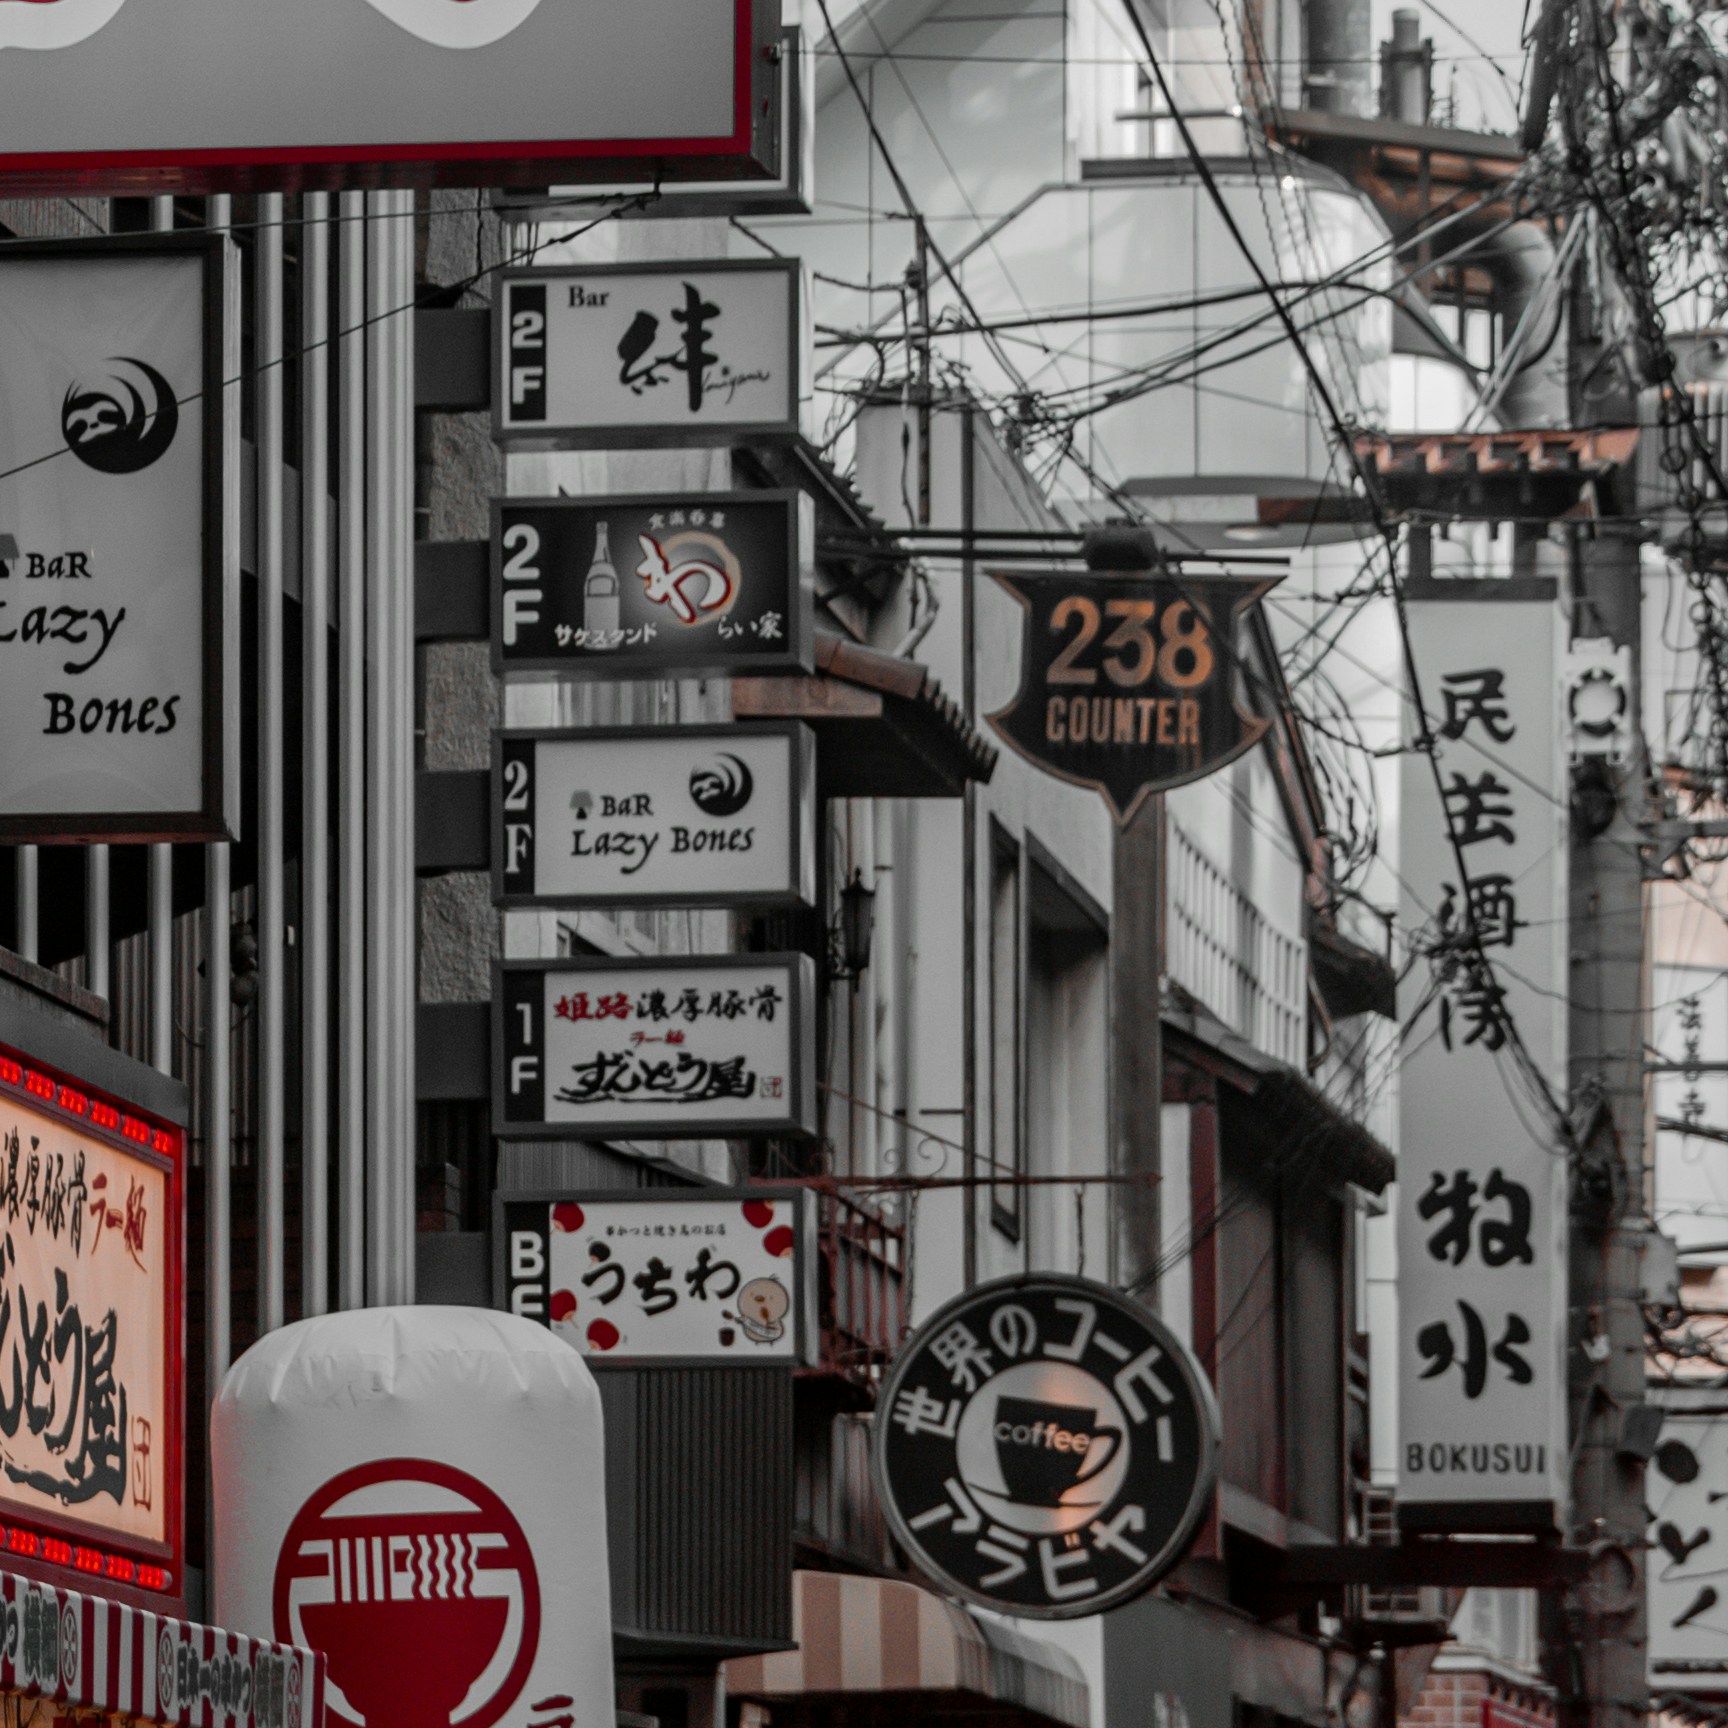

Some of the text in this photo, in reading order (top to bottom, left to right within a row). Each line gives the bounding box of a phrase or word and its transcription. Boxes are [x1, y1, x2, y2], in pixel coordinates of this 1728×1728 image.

[569, 286, 610, 308] Bar
[618, 281, 721, 412] 絆
[1046, 597, 1215, 689] 238
[43, 692, 180, 735] Bones
[1046, 696, 1200, 745] COUNTER
[571, 824, 755, 874] Lazy Bones
[553, 984, 782, 1022] 姫路濃厚豚骨
[581, 1241, 741, 1317] うちわ
[1417, 1168, 1538, 1400] 牧水
[893, 1298, 1174, 1462] 世界のコーヒー
[994, 1421, 1091, 1453] coffee
[1406, 1443, 1546, 1475] BOKUSUI
[910, 1477, 1148, 1599] アラビヤ
